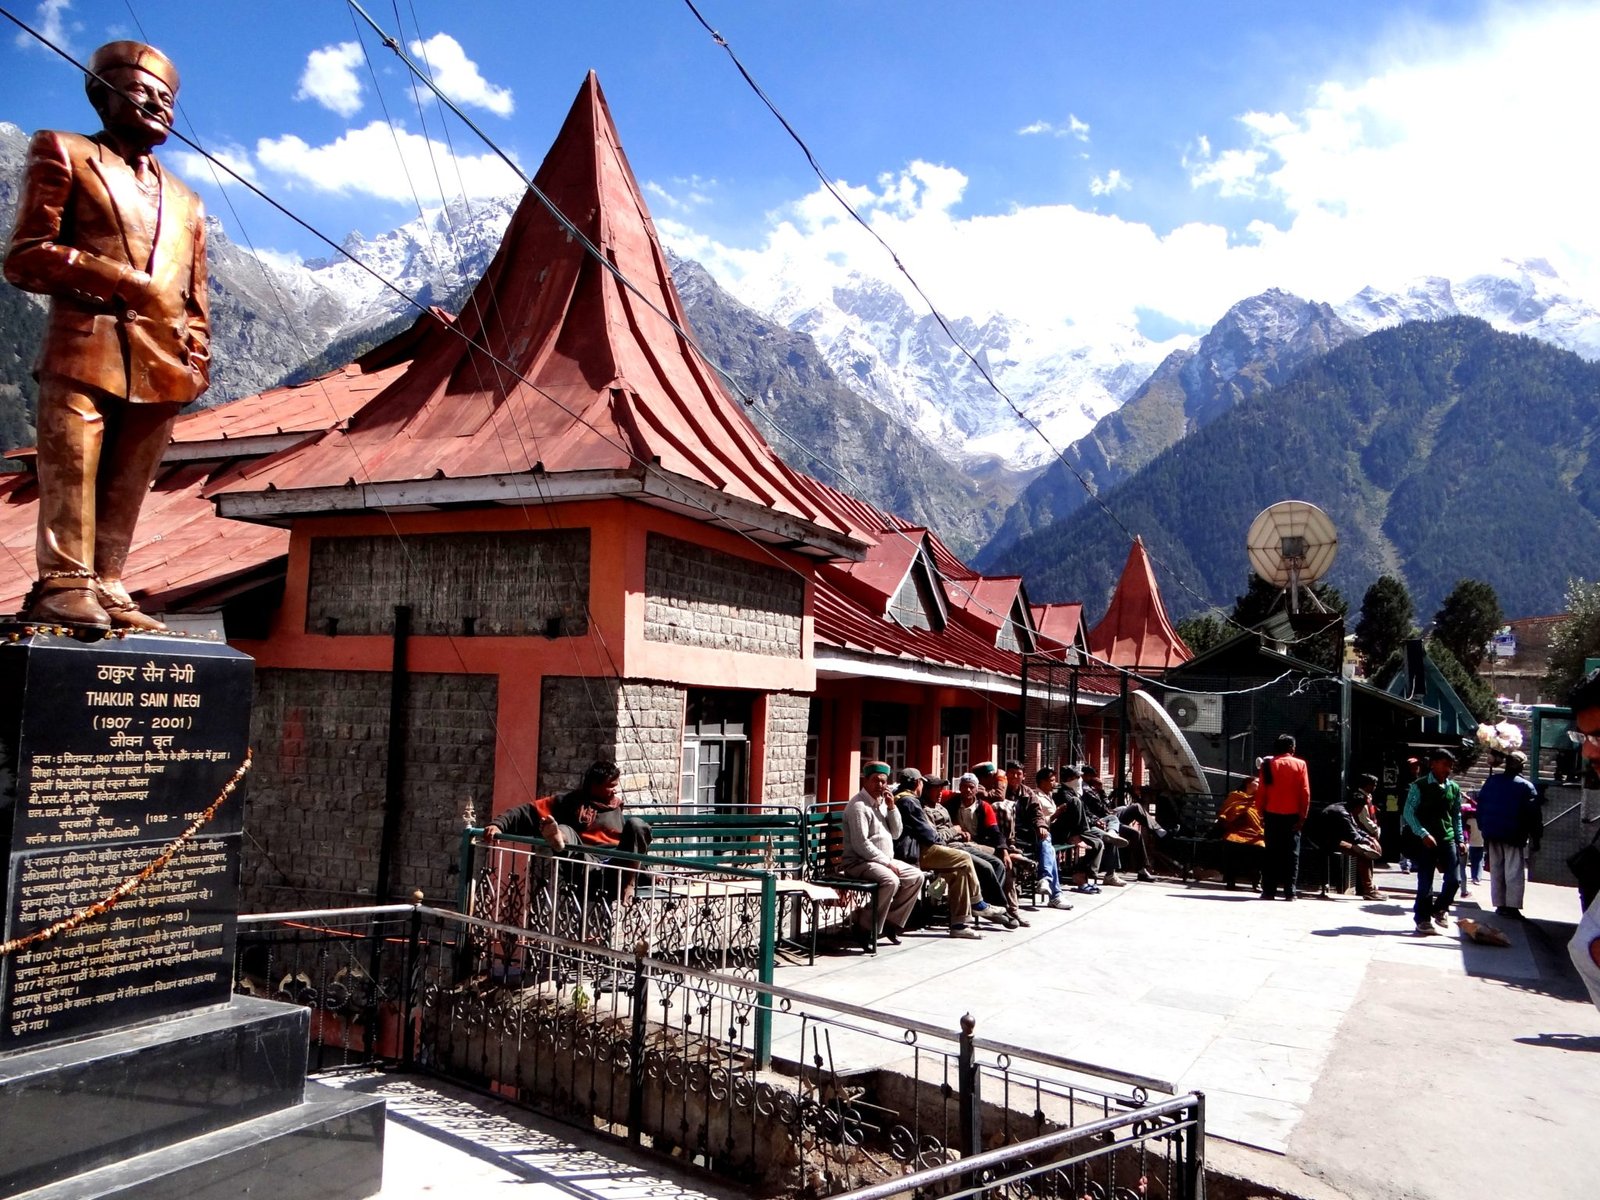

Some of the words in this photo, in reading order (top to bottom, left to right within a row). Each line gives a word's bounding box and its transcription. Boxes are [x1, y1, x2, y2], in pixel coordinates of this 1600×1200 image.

[97, 664, 137, 684] ठाकुर
[142, 661, 166, 682] सैन
[169, 663, 195, 683] नेगी
[86, 692, 134, 706] THAKUR
[140, 693, 168, 707] SAIN
[174, 694, 200, 708] NEGI
[109, 731, 144, 747] जीवन
[152, 735, 174, 749] वृत
[115, 751, 125, 762] को
[126, 750, 143, 761] जिला
[128, 776, 149, 786] सोलन
[76, 803, 100, 816] लाहौर
[59, 817, 92, 829] सरकारी
[62, 850, 97, 863] अधिकारी
[110, 917, 136, 931] जीवन
[33, 952, 53, 962] 1970
[62, 943, 84, 957] पहली
[162, 930, 170, 941] के
[60, 960, 80, 971] 1972
[14, 981, 36, 992] 1977
[12, 1008, 33, 1020] 1977
[44, 1002, 64, 1013] 1993
